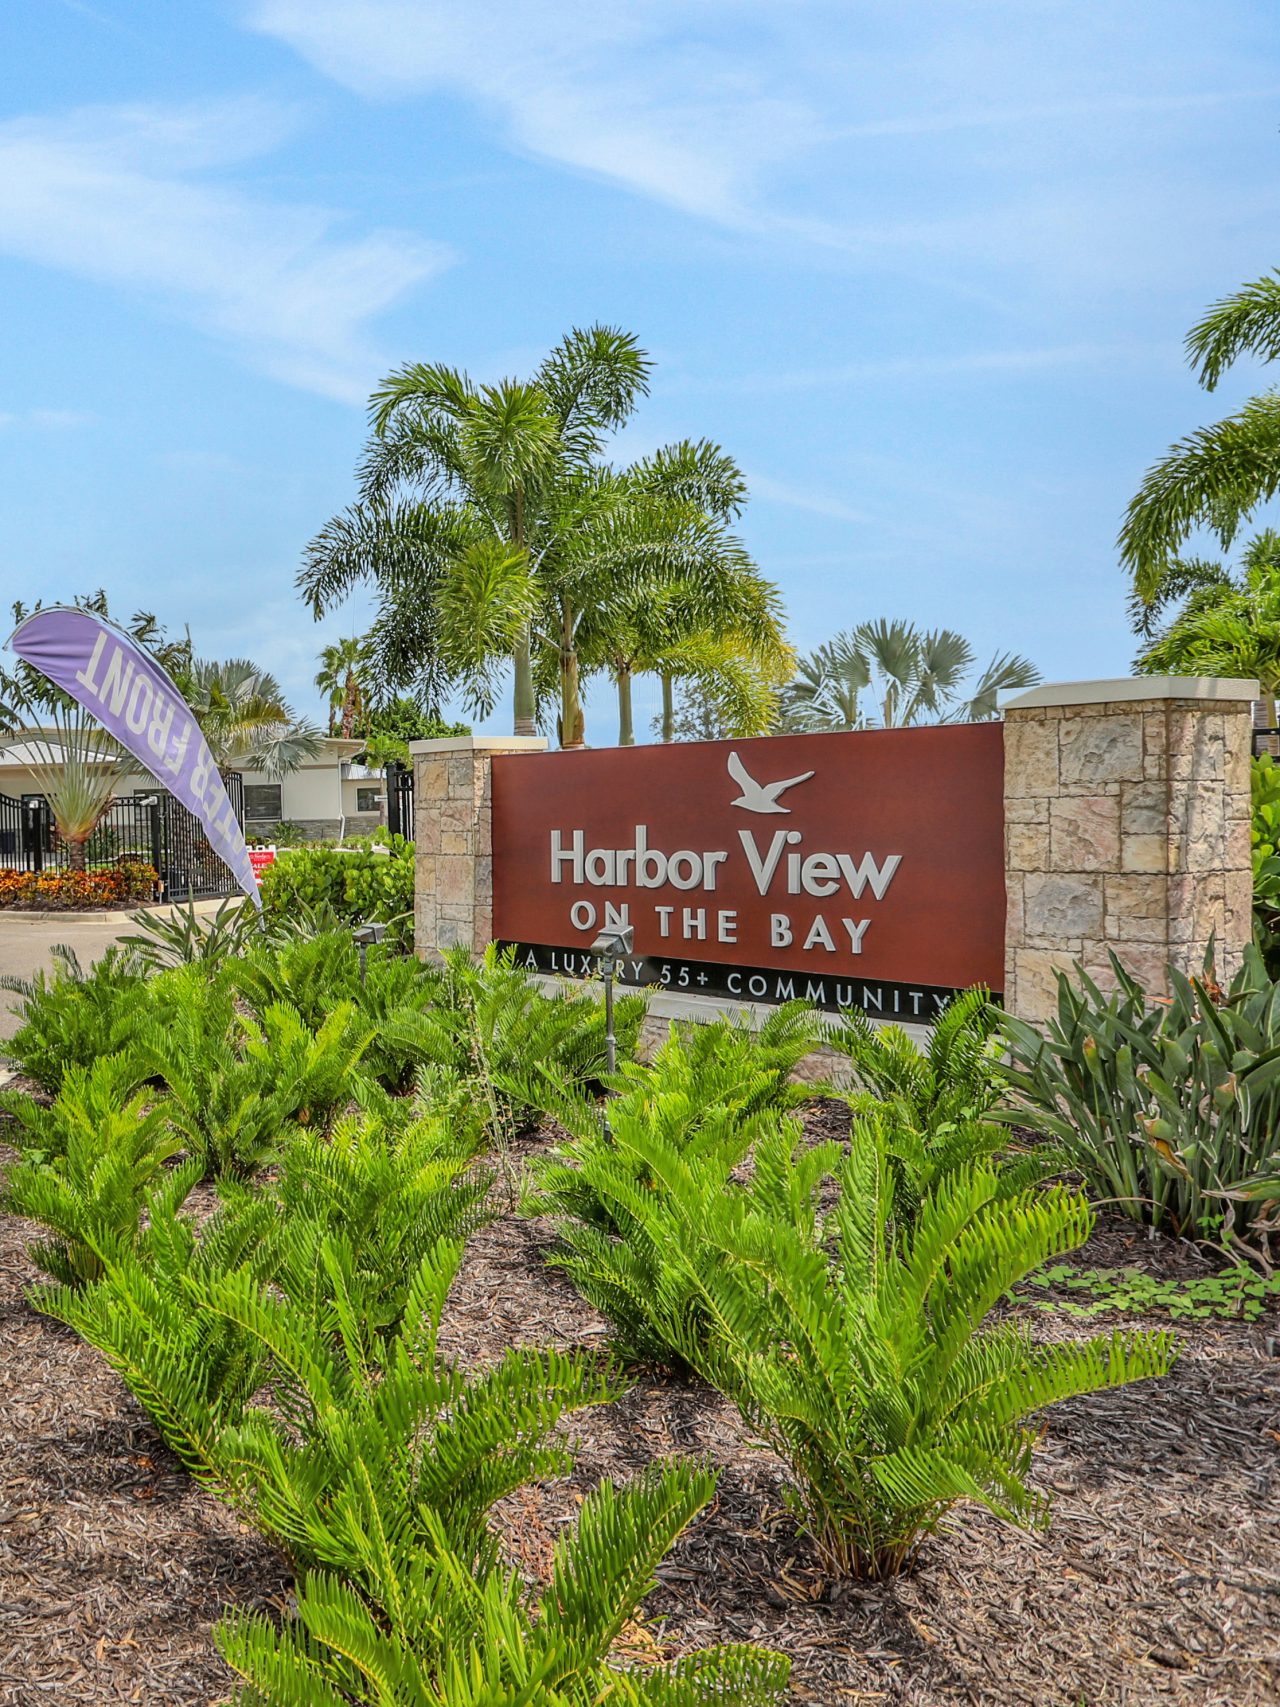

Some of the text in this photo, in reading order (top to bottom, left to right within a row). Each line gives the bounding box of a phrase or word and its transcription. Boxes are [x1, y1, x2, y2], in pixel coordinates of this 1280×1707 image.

[76, 630, 193, 776] FRONT
[551, 825, 902, 900] Harbor View
[570, 901, 871, 954] ON THE BAY
[525, 950, 537, 967] A
[660, 965, 708, 987] 55+
[727, 973, 951, 1017] COMMUNITY
